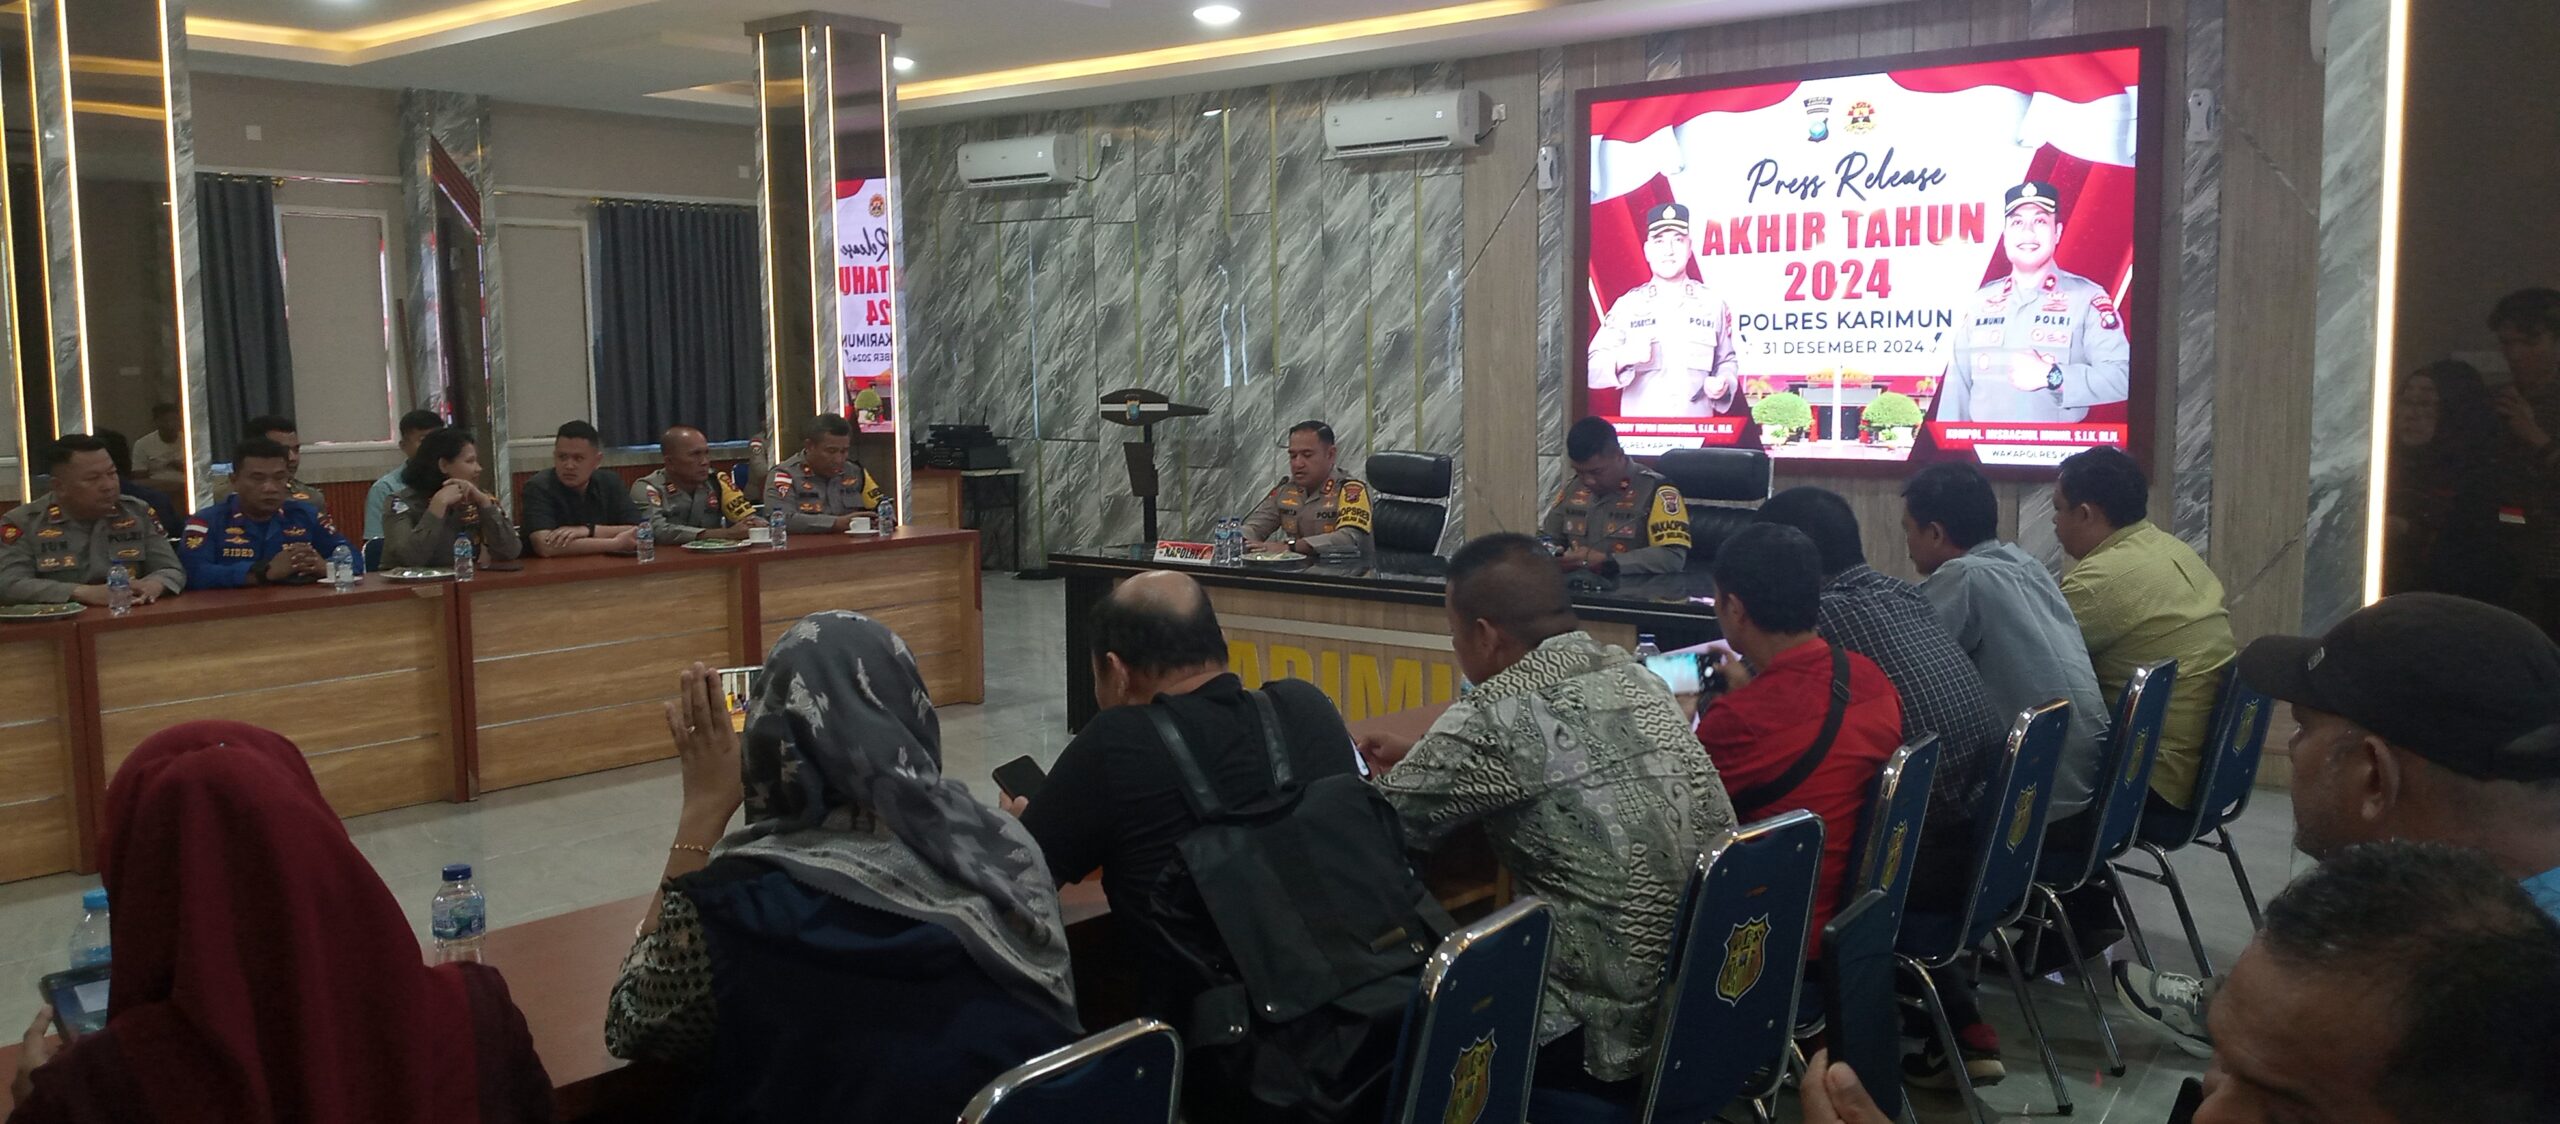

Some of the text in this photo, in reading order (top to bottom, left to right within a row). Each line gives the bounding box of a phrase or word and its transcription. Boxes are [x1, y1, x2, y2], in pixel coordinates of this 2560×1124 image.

[1747, 147, 1947, 203] Press Release
[1702, 202, 1985, 256] AKHIR TAHUN
[1784, 258, 1891, 301] 2024
[1738, 309, 1953, 331] POLRES KARIMUN
[2035, 315, 2070, 327] POLRI
[1763, 340, 1925, 354] 31 DESEMBER 2024
